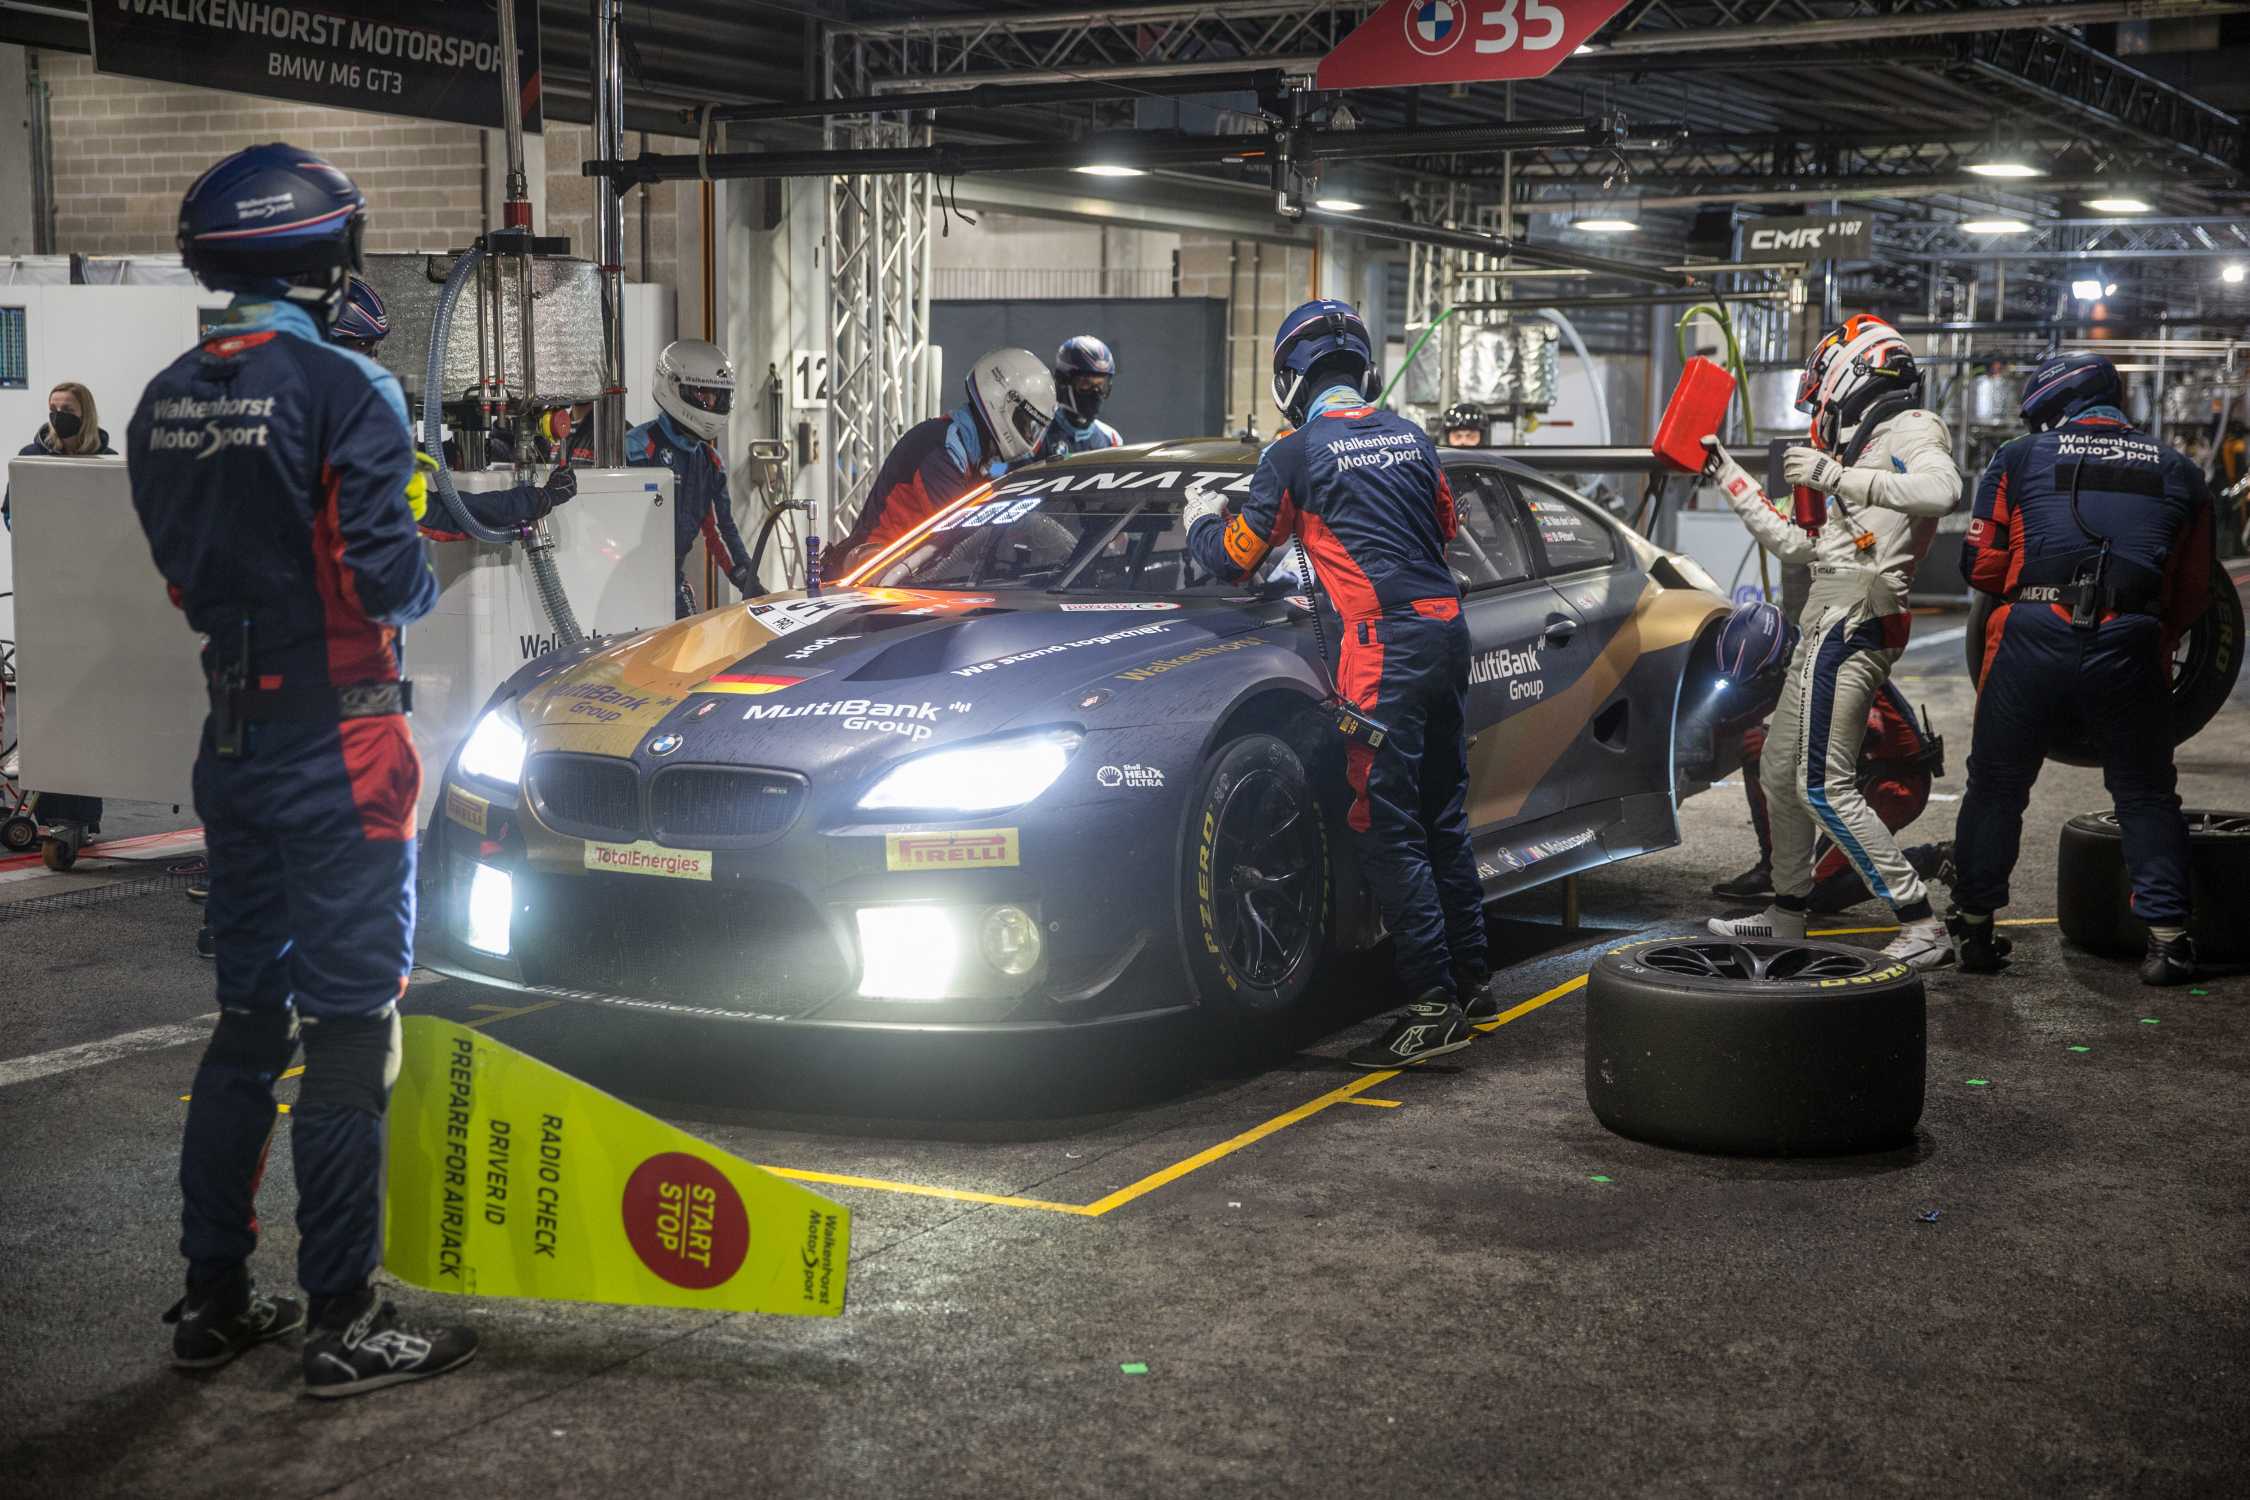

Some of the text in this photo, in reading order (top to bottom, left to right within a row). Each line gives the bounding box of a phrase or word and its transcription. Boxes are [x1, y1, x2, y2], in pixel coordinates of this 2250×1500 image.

[1475, 0, 1565, 53] 35
[268, 53, 403, 94] BMW M6 GT3
[1751, 227, 1824, 250] CMR
[154, 396, 274, 419] Walkenhorst
[151, 420, 269, 460] MotorSport
[1327, 432, 1416, 455] Walkenhorst
[2058, 433, 2160, 454] Walkenhorst
[1337, 447, 1423, 472] MotorSport
[2057, 444, 2160, 464] MotorSport
[951, 660, 998, 678] We
[1509, 679, 1544, 701] Group
[742, 699, 941, 722] MultiBank
[843, 716, 932, 742] Group
[1124, 766, 1166, 779] HELIX
[1126, 778, 1164, 787] ULTRA
[595, 846, 699, 874] TotalEnergies
[898, 836, 1007, 863] PIRELLI
[447, 1037, 474, 1145] PREPARE
[444, 1145, 466, 1194] FOR
[484, 1119, 511, 1226] DRIVER ID
[533, 1112, 563, 1259] RADIO CHECK
[656, 1180, 682, 1252] STOP
[685, 1182, 717, 1268] START
[801, 1208, 822, 1303] MotorSport
[819, 1214, 838, 1305] Walkenhorst
